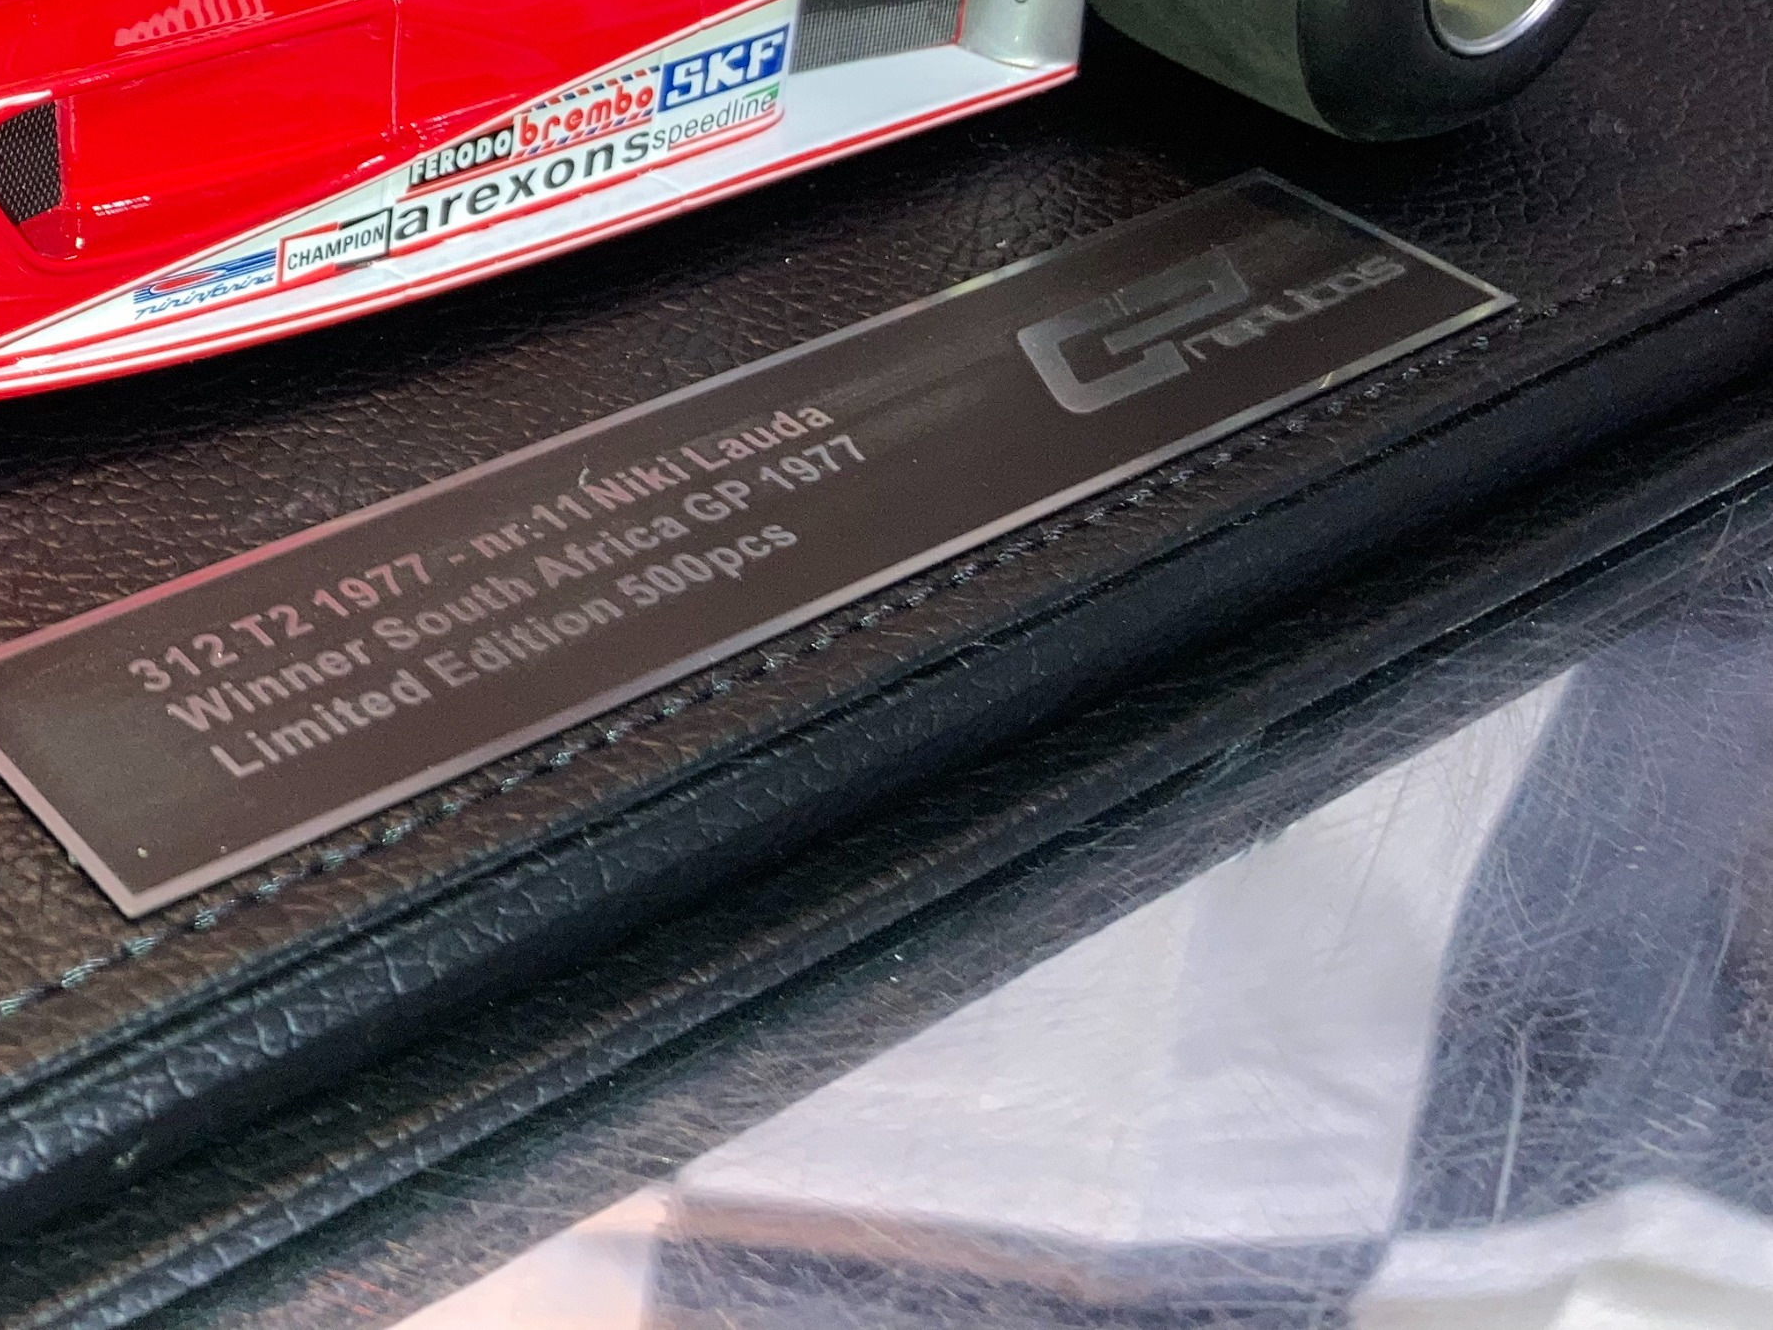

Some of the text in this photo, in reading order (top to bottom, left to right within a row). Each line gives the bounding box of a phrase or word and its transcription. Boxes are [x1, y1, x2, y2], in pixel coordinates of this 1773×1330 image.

[410, 81, 654, 186] FERODO brembo
[666, 31, 783, 107] SKF
[393, 88, 773, 240] arexons speedline
[287, 224, 385, 271] CHAMPION
[128, 633, 239, 692] 312
[230, 604, 314, 647] T2
[313, 553, 432, 617] 1977
[583, 456, 691, 510] Niki
[681, 407, 835, 471] Lauda
[166, 433, 866, 731] Winner South Africa GP 1977
[209, 524, 799, 778] Limited Edition 500pcs
